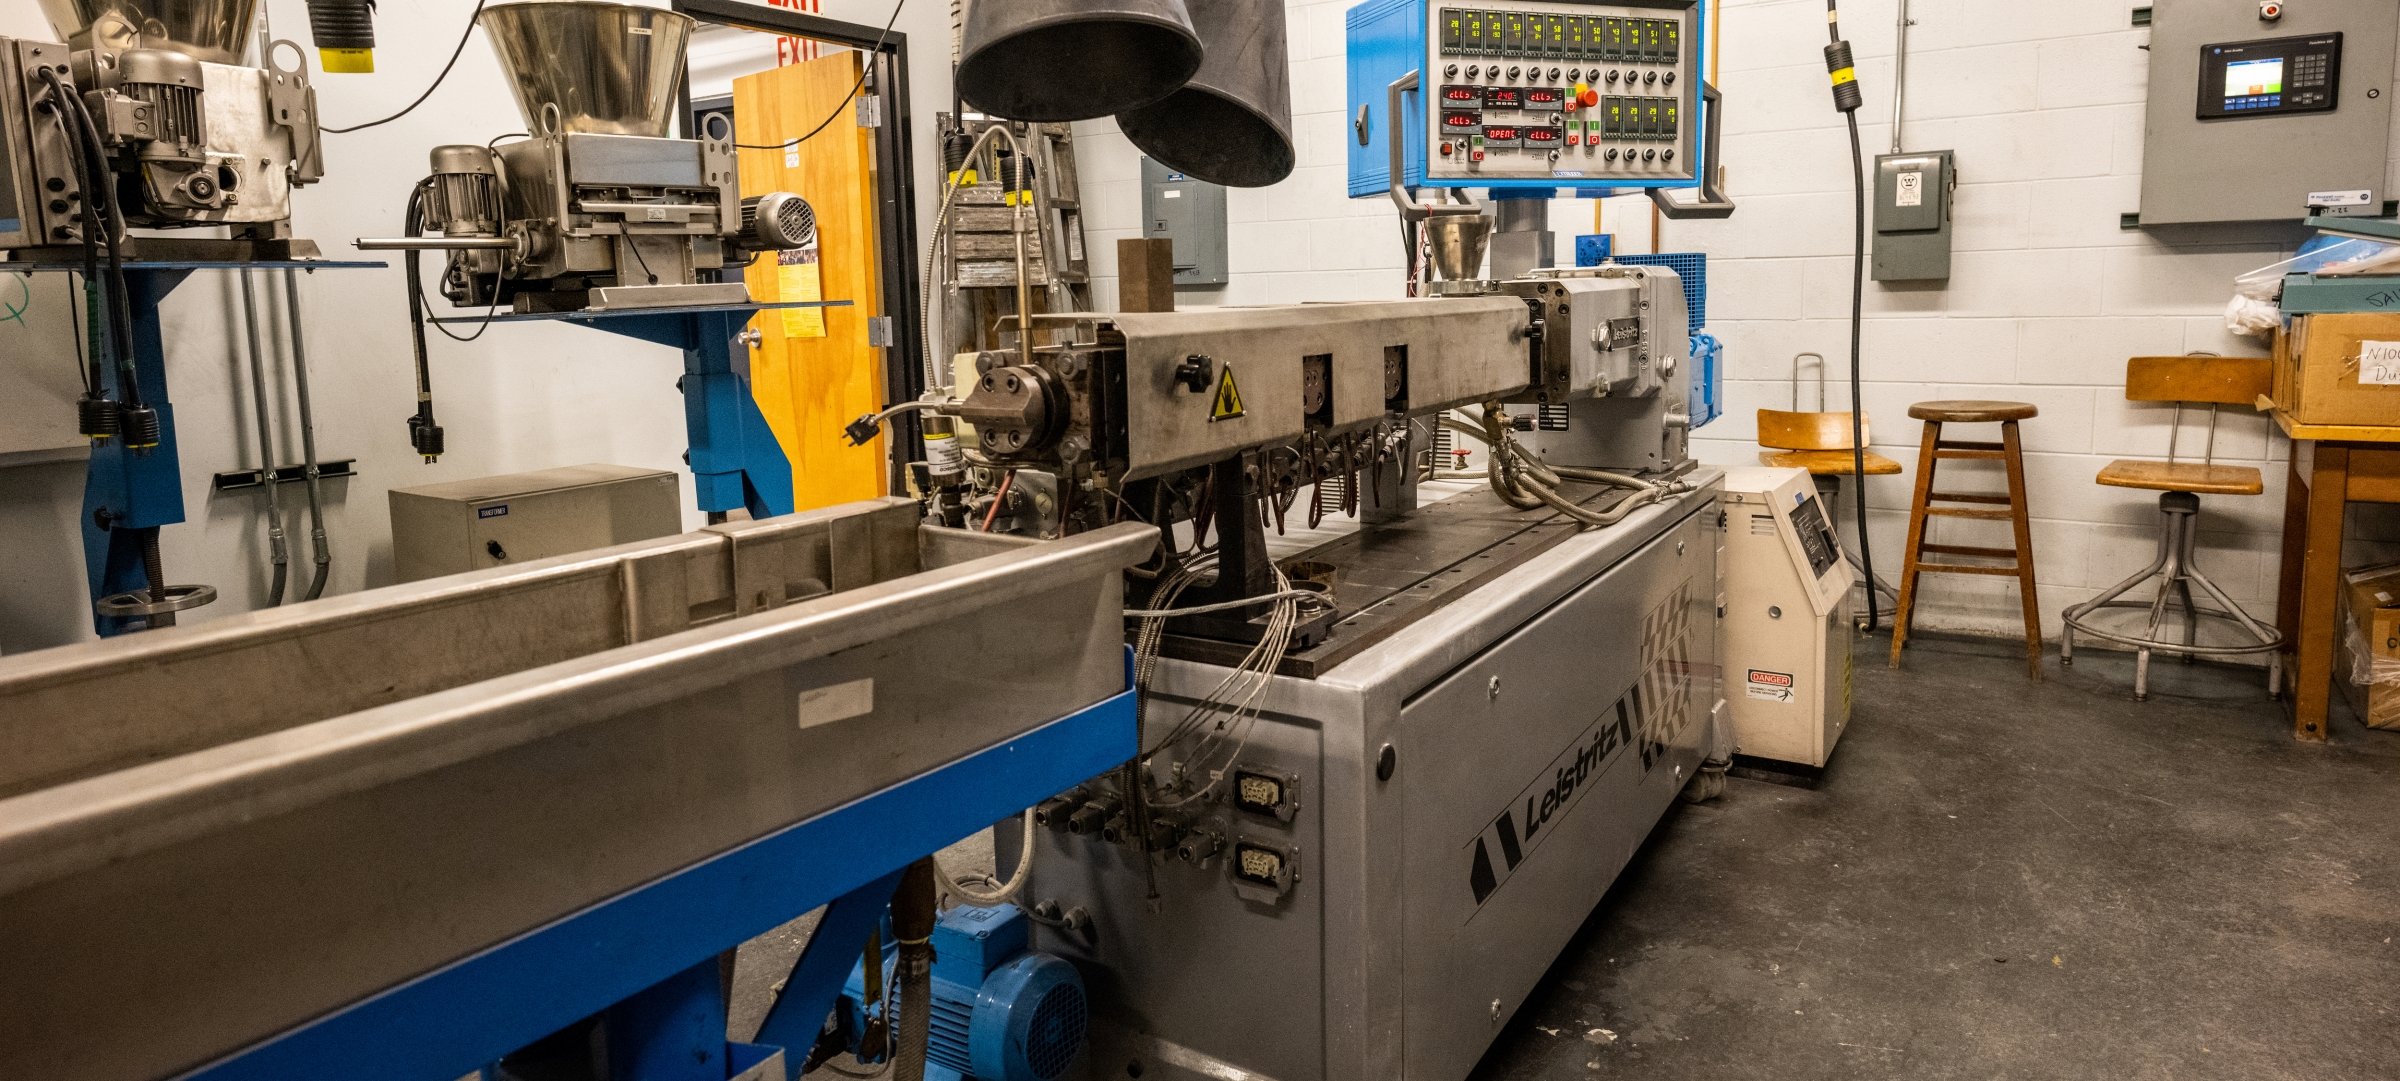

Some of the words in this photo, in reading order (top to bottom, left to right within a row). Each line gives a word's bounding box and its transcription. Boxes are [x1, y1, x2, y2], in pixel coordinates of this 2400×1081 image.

[2366, 347, 2400, 360] N10
[2375, 364, 2400, 381] Du
[1753, 673, 1788, 684] DANGER
[1525, 721, 1619, 843] Leistritz
